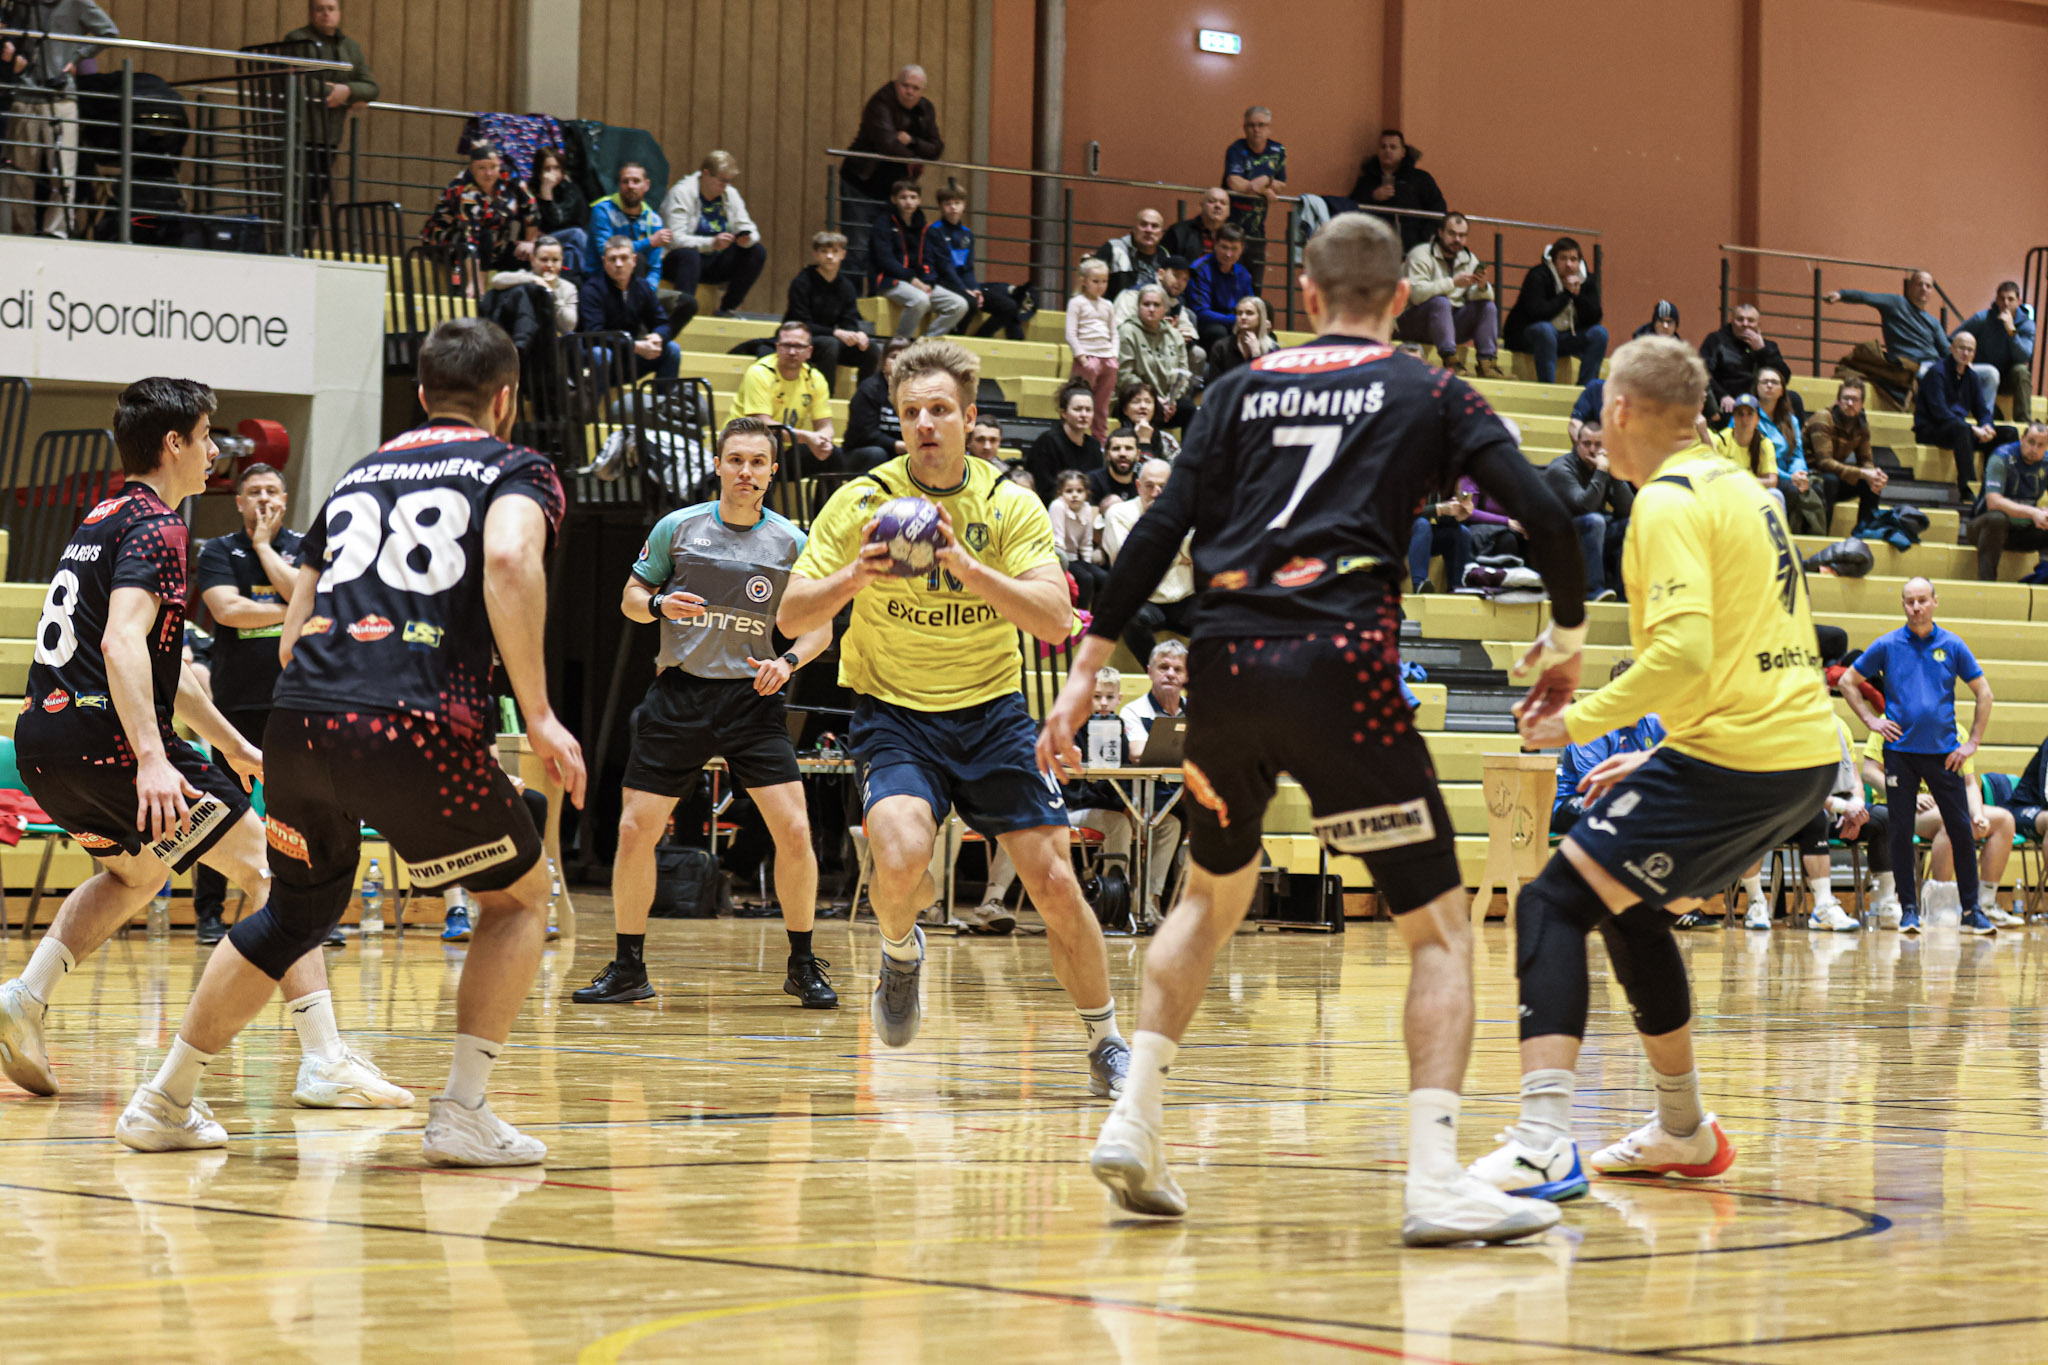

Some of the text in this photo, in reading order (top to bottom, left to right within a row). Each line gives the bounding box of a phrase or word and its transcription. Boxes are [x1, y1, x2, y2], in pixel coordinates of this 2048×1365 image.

[47, 291, 288, 348] Spordihoone
[1266, 425, 1343, 530] 7
[316, 487, 471, 595] 98
[34, 568, 80, 668] 8
[446, 843, 508, 871] PACKING
